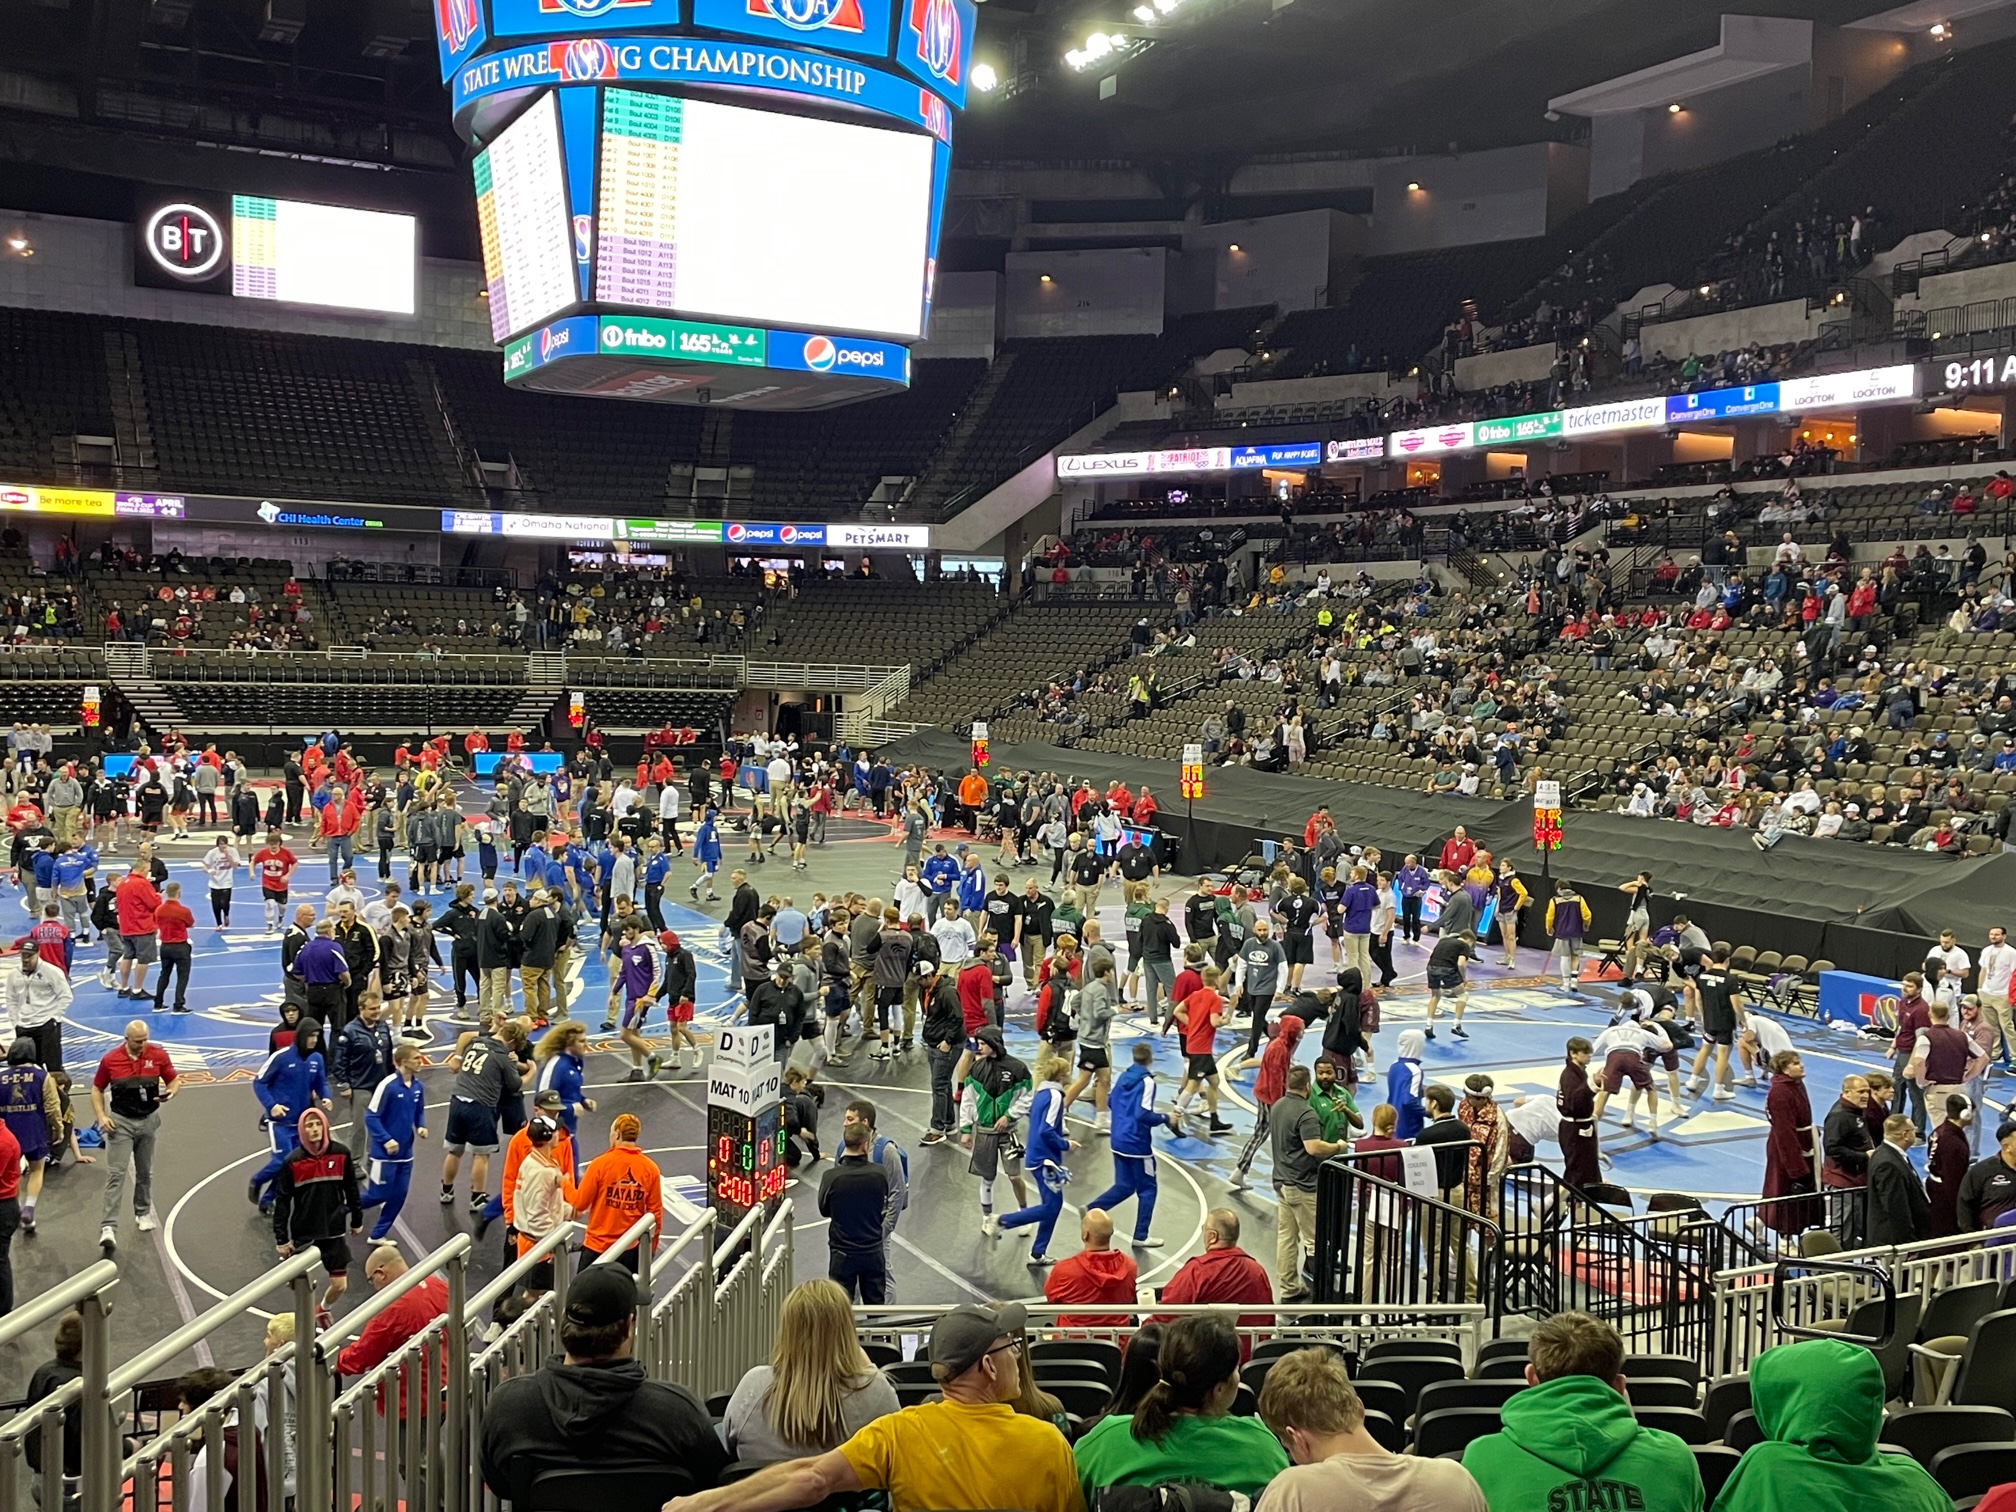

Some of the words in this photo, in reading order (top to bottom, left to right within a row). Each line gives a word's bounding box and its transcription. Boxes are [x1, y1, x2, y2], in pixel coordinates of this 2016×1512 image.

[463, 60, 500, 96] STATE
[649, 45, 867, 95] CHAMPIONSHIP
[636, 278, 650, 286] 1015
[657, 281, 672, 289] A113
[656, 300, 671, 308] D113
[625, 331, 666, 348] fnbo
[679, 332, 712, 353] 165
[838, 349, 884, 368] pepsi
[1945, 357, 1995, 389] 9:11
[1853, 386, 1896, 398] LOCKTON
[1726, 400, 1775, 413] ConvergeOne
[1794, 394, 1835, 405] LOCKTON
[1568, 403, 1660, 428] ticketmaster
[1670, 407, 1716, 420] ConvergeOne
[1490, 427, 1510, 438] fnbo
[1082, 458, 1139, 470] LEXUS
[1169, 451, 1200, 463] PATRIOT
[1234, 454, 1267, 466] AQUAFINA
[3, 493, 28, 502] Lipton
[40, 496, 52, 504] Be
[54, 498, 83, 506] more
[86, 498, 102, 507] tea
[155, 499, 183, 508] APRIL
[278, 513, 296, 523] CHI
[298, 514, 331, 525] Health
[332, 516, 364, 526] Center
[522, 518, 562, 529] Omaha
[565, 520, 609, 531] National
[746, 529, 773, 539] pepsi
[797, 530, 823, 540] pepsi
[845, 531, 910, 544] PETSMART
[720, 1032, 733, 1051] D
[751, 1036, 759, 1056] D
[462, 1050, 489, 1075] 84
[1, 1073, 34, 1084] S-E-M
[765, 1076, 778, 1093] 10
[710, 1079, 737, 1099] MAT
[738, 1087, 750, 1105] 10
[778, 1129, 786, 1155] 0
[719, 1136, 731, 1163] 0
[760, 1139, 768, 1166] 0
[742, 1144, 753, 1171] 0
[718, 1171, 753, 1208] 2:00
[760, 1164, 785, 1202] 2:00
[606, 1186, 645, 1201] BAYARD
[1547, 1479, 1645, 1512] STATE
